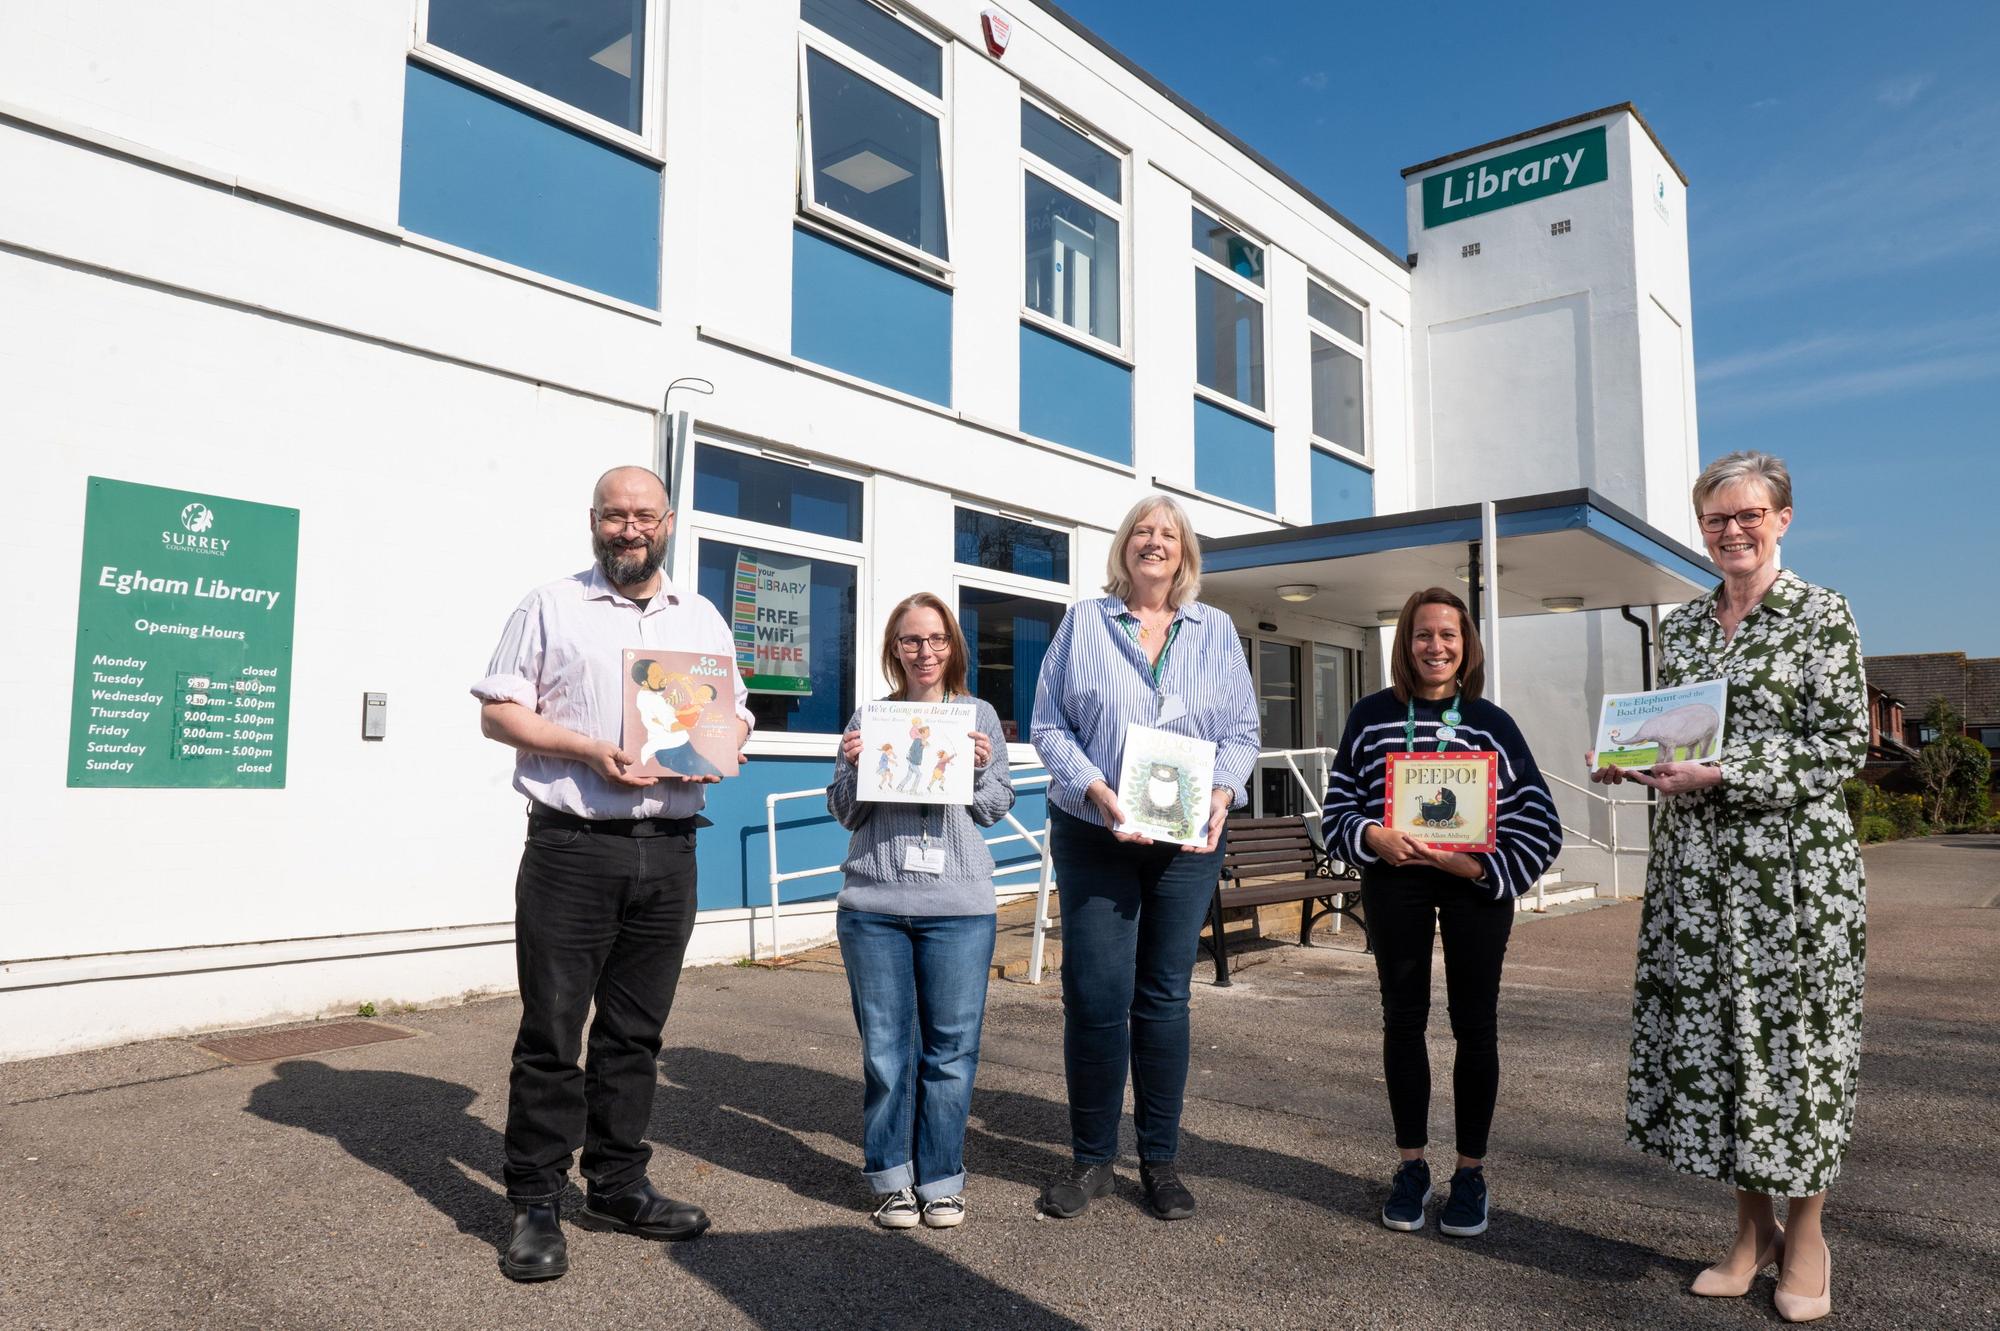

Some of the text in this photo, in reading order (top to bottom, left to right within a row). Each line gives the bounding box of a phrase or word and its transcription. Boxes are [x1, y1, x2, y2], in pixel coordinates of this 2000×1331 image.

[1442, 148, 1585, 209] Library
[161, 531, 231, 551] SURREY
[165, 544, 225, 557] COUNTY COUNCIL
[757, 568, 776, 578] your
[98, 566, 281, 610] Egham Library
[757, 577, 807, 594] LIBRARY
[757, 606, 798, 625] FREE
[134, 619, 246, 640] Opening Hours
[756, 625, 794, 643] WiFi
[700, 656, 717, 667] SO
[756, 644, 803, 661] HERE
[92, 654, 278, 677] Monday closed
[689, 665, 728, 677] MUCH
[92, 672, 144, 688] Tuesday
[91, 689, 164, 706] Wednesday
[234, 697, 275, 710] 5.00pm
[1634, 694, 1677, 706] Elephant
[1678, 691, 1692, 700] and
[90, 706, 150, 722] Thursday
[184, 711, 225, 723] 9.00am
[233, 713, 274, 726] 5.00pm
[867, 704, 886, 713] We're
[889, 705, 912, 715] Going
[930, 706, 949, 716] Bear
[950, 706, 971, 716] Hunt
[1617, 705, 1664, 717] Bad Baby
[88, 724, 130, 739] Friday
[183, 728, 224, 739] 9.00am
[232, 730, 273, 743] 5.00pm
[86, 741, 146, 756] Saturday
[182, 745, 223, 755] 9.00am
[231, 746, 272, 759] 5.00pm
[85, 759, 273, 774] Sunday closed
[1404, 767, 1477, 785] PEEPO!
